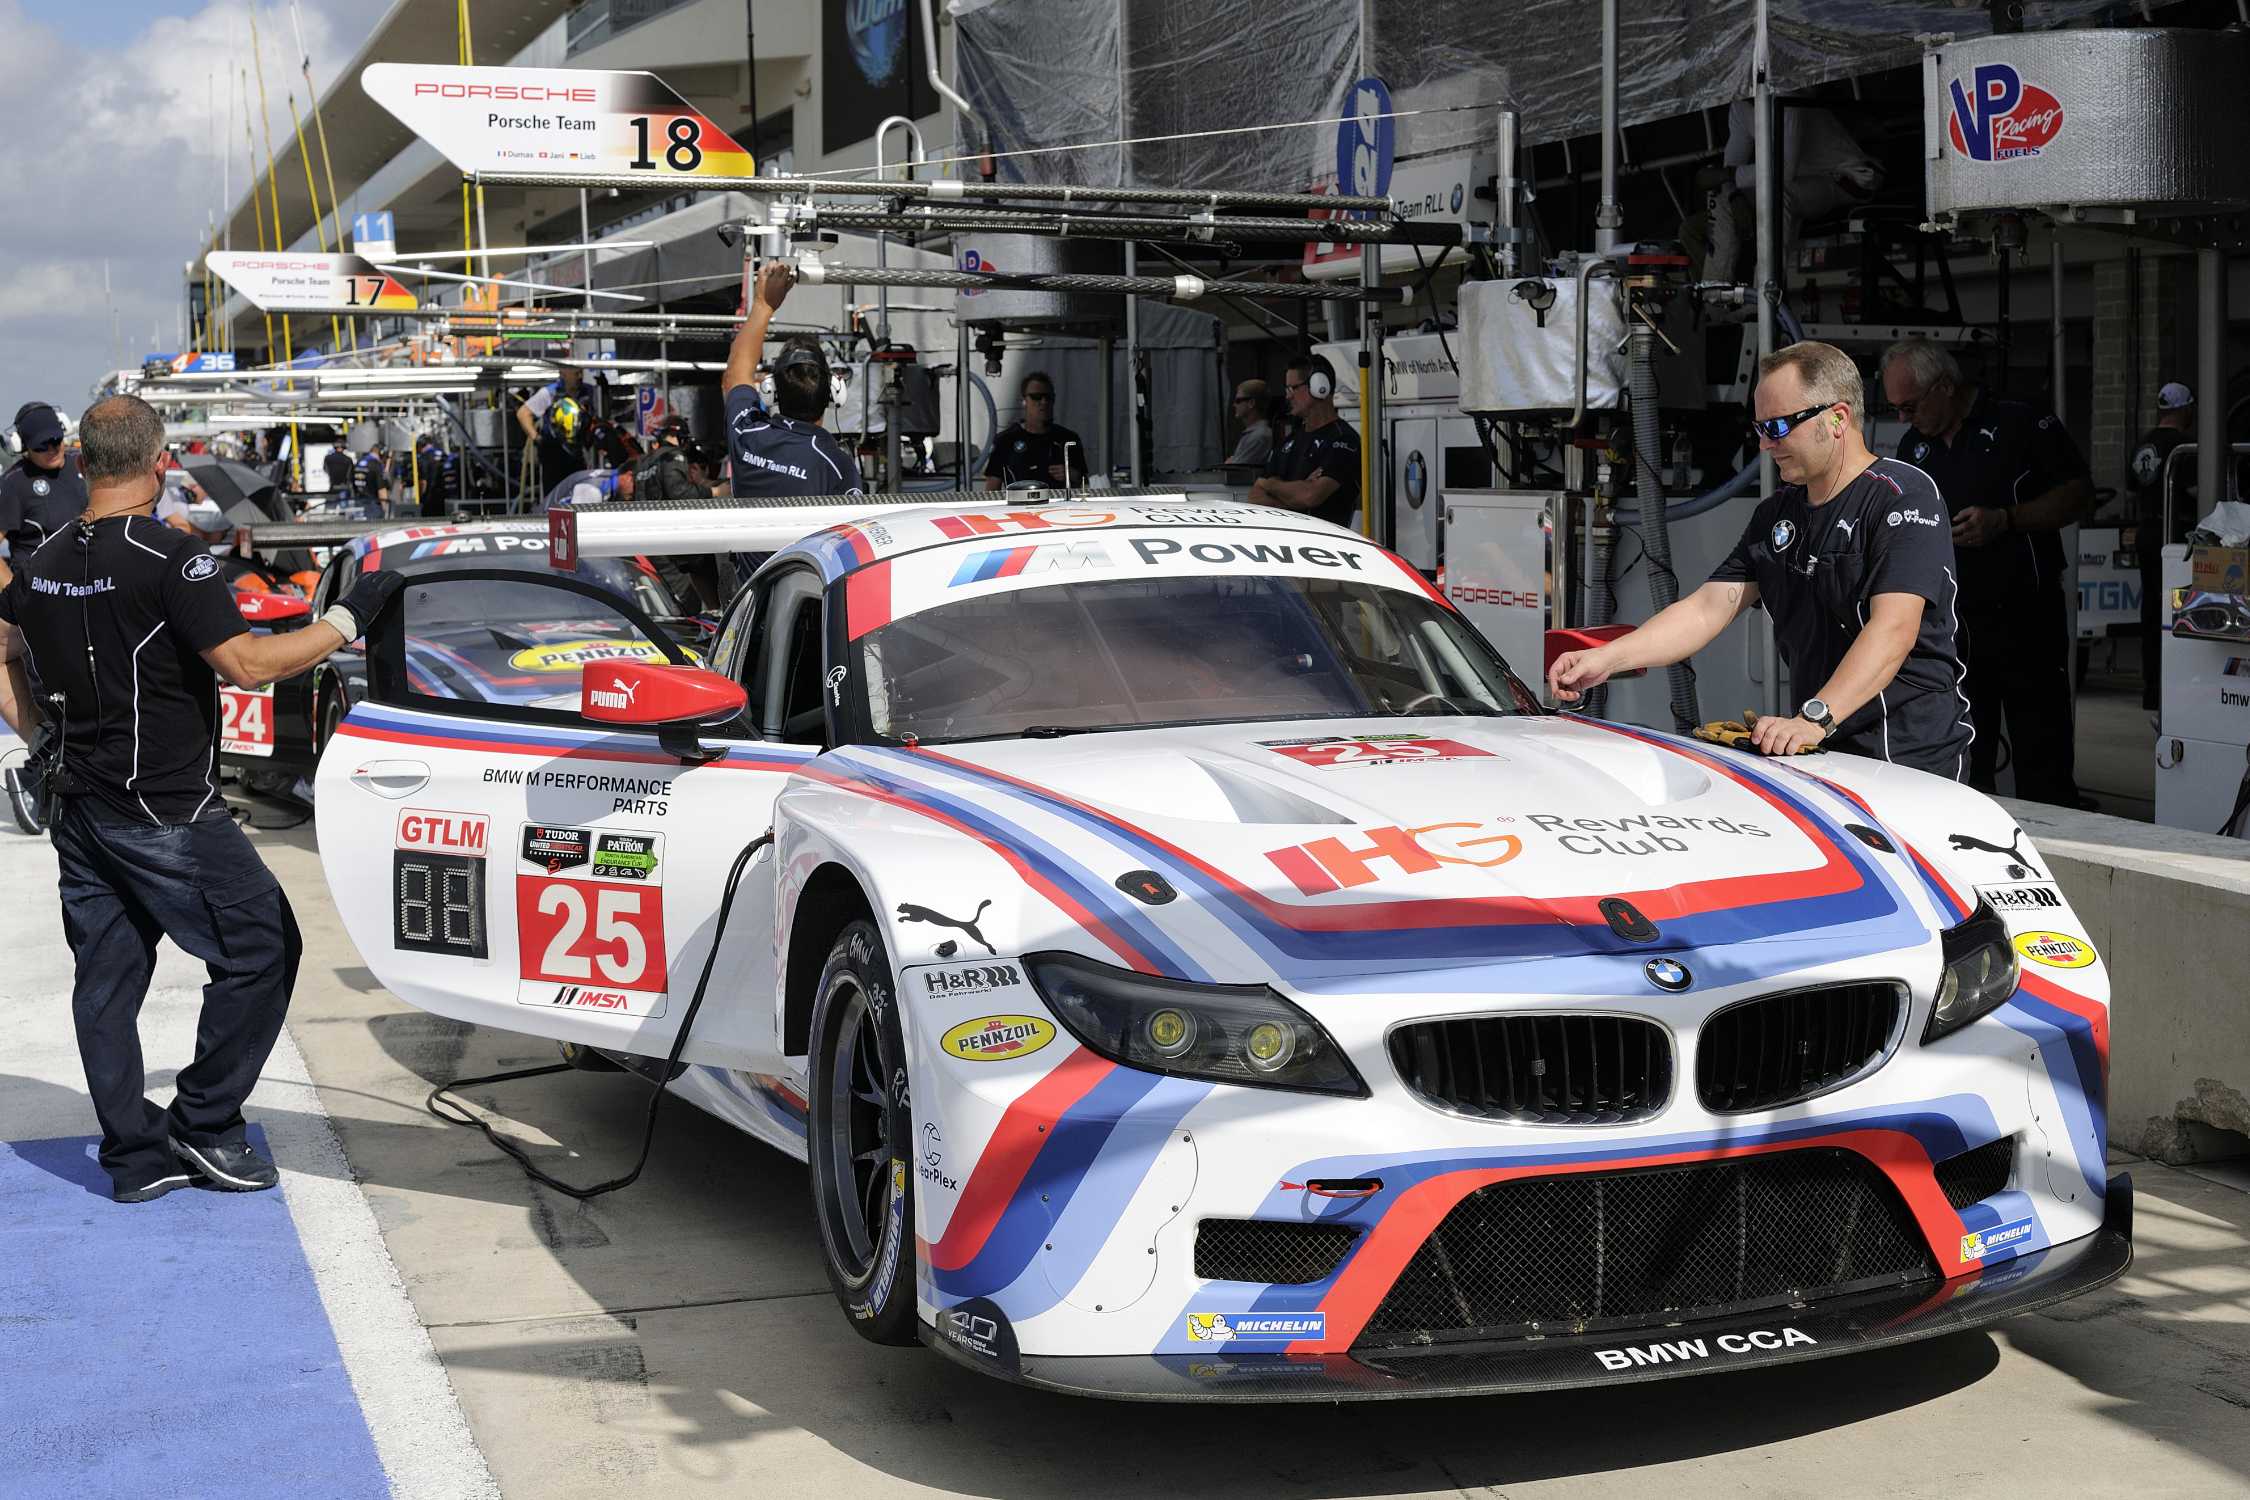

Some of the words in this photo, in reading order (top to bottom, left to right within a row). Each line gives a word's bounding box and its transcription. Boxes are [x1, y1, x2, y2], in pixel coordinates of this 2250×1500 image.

[415, 83, 597, 102] PORSCHE
[488, 113, 551, 130] Porsche
[556, 115, 597, 131] Team
[1950, 64, 2021, 161] VP
[1995, 107, 2062, 149] Racing
[508, 150, 534, 160] Dumas
[629, 117, 703, 172] 18
[1997, 147, 2041, 159] FUELS
[1425, 193, 1445, 215] RLL
[355, 212, 392, 242] 11
[232, 260, 330, 270] PORSCHE
[272, 276, 305, 286] Porsche
[309, 277, 331, 286] Team
[346, 278, 386, 306] 17
[200, 353, 235, 371] 36
[1416, 360, 1438, 374] North
[742, 451, 767, 469] BMW
[767, 459, 787, 474] Team
[788, 465, 808, 480] RLL
[929, 507, 1117, 540] IHG
[1127, 505, 1312, 522] Rewards
[1145, 513, 1242, 525] Club
[1128, 538, 1363, 571] Power
[31, 576, 62, 595] BMW
[63, 582, 93, 597] Team
[93, 576, 116, 593] RLL
[1452, 586, 1539, 609] PORSCHE
[591, 690, 627, 709] PUMA
[221, 693, 266, 742] 24
[1307, 741, 1441, 763] 25
[483, 768, 523, 785] BMW
[526, 771, 541, 787] M
[544, 772, 672, 796] PERFORMANCE
[613, 797, 668, 817] PARTS
[402, 815, 486, 849] GTLM
[545, 829, 580, 842] TUDOR
[607, 840, 644, 853] PATRÓN
[1263, 822, 1523, 898] IHG
[1525, 813, 1772, 839] Rewards
[1557, 833, 1689, 857] Club
[1984, 888, 2033, 907] H&R
[538, 884, 647, 984] 25
[2026, 941, 2082, 957] PENNZOIL
[924, 968, 986, 993] H&R
[576, 990, 628, 1010] IMSA
[958, 1022, 1040, 1052] PENNZOIL
[1986, 1223, 2032, 1246] MICHELIN
[873, 1209, 900, 1309] MICHELIN
[950, 1311, 998, 1342] 40
[1236, 1320, 1323, 1332] MICHELIN
[947, 1328, 973, 1348] YEARS
[1594, 1338, 1709, 1371] BMW
[1717, 1327, 1818, 1354] CCA
